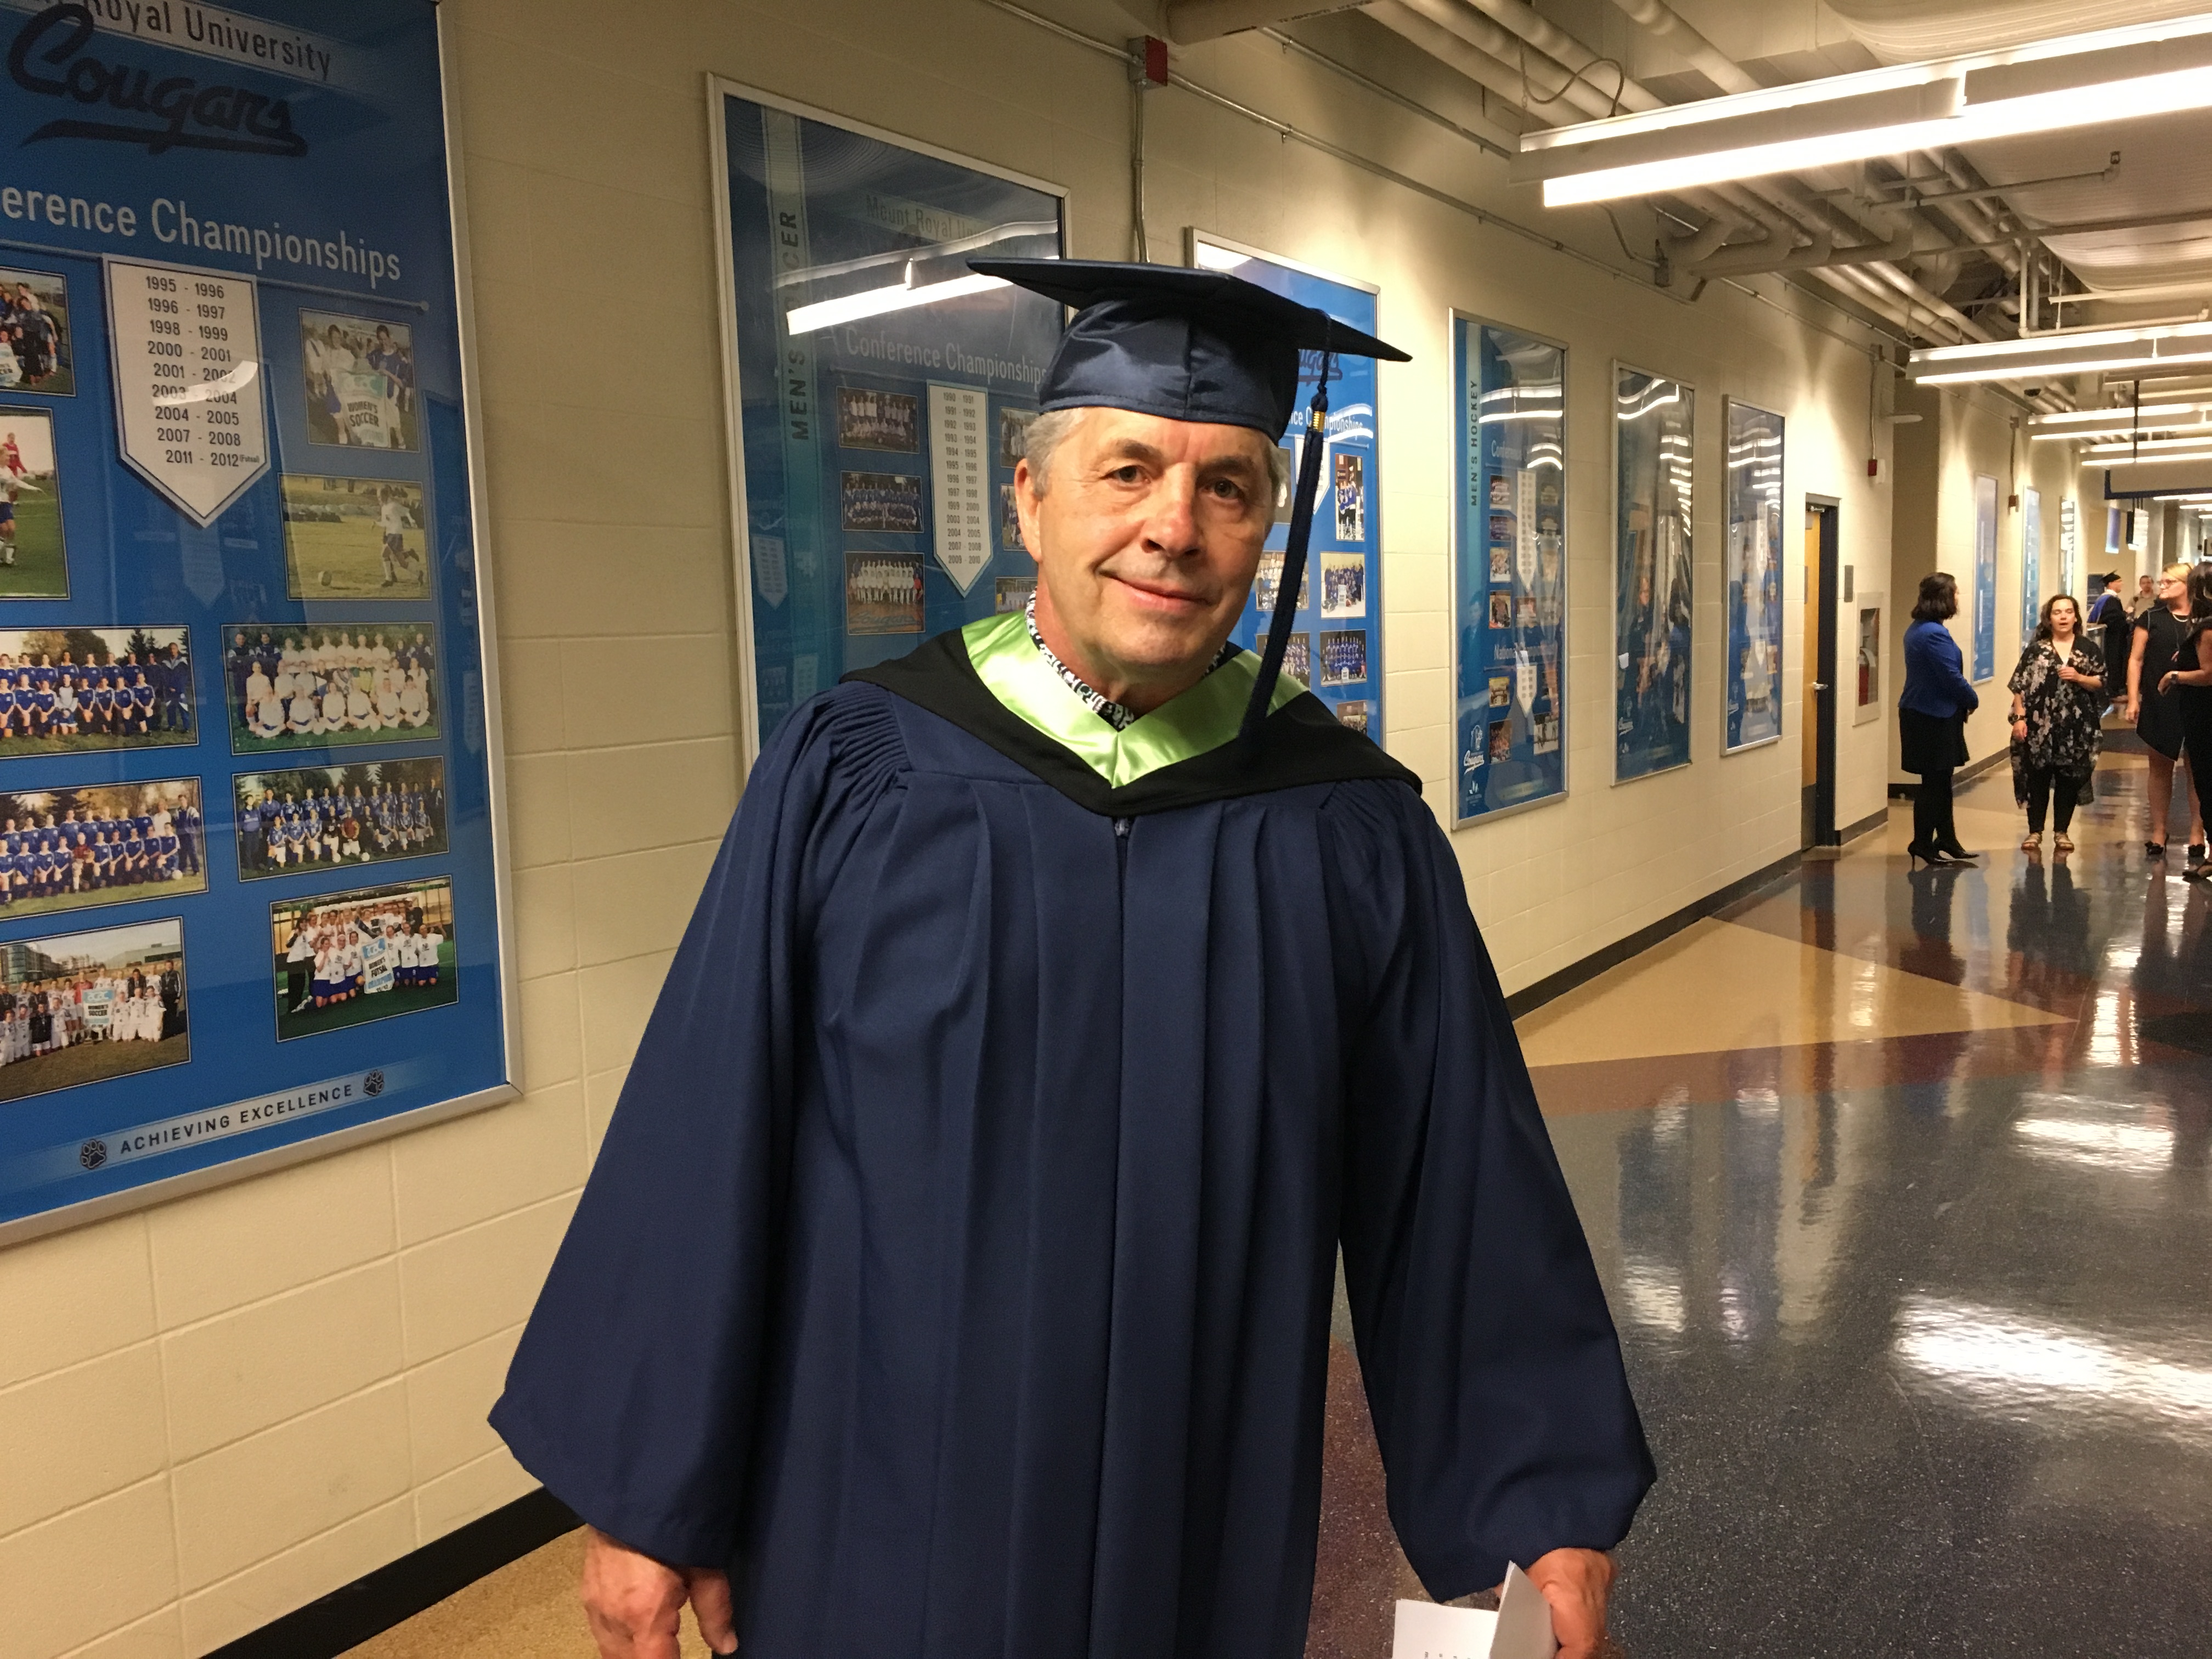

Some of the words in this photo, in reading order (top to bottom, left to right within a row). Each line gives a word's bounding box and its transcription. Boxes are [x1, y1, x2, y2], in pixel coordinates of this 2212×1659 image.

[185, 6, 330, 81] University
[7, 3, 308, 157] Cougars
[865, 195, 909, 225] Mount
[916, 209, 952, 240] Royal
[151, 198, 402, 289] Championships
[146, 276, 177, 292] 1995
[195, 283, 224, 298] 1996
[148, 298, 178, 314] 1996
[197, 304, 225, 319] 1997
[150, 319, 180, 336] 1998
[199, 325, 228, 341] 1999
[148, 341, 182, 357] 2000
[201, 347, 230, 362] 2001
[846, 329, 940, 368] Conference
[154, 363, 184, 379] 2001
[152, 384, 187, 400] 2003
[205, 389, 237, 404] 2004
[788, 348, 809, 440] MEN'S
[155, 406, 189, 421] 2004
[207, 410, 239, 425] 2005
[349, 412, 379, 427] SOCCER
[963, 408, 975, 418] 1992
[944, 420, 957, 429] 1992
[157, 427, 190, 442] 2007
[209, 432, 241, 446] 2008
[166, 450, 193, 464] 2011
[211, 453, 239, 467] 2012
[120, 1115, 230, 1154] ACHIEVING
[239, 1084, 353, 1123] EXCELLENCE
